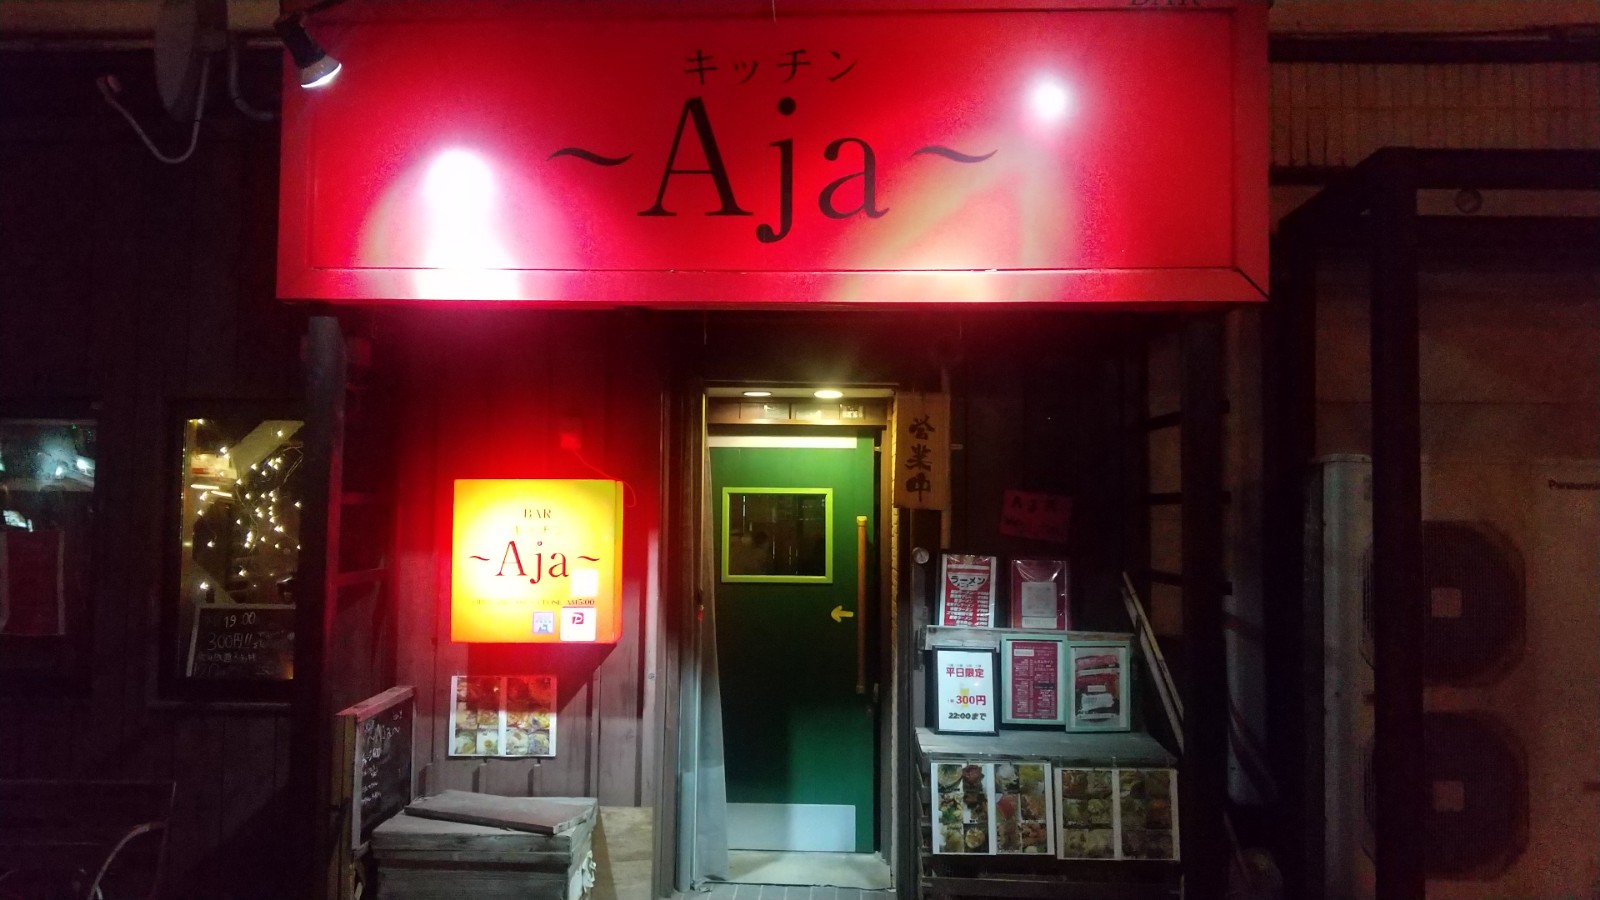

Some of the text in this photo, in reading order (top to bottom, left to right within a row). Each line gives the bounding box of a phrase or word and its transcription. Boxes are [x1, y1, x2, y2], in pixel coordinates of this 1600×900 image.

[683, 48, 859, 85] キッチン
[904, 414, 936, 502] 営業中
[524, 508, 552, 519] BAR
[950, 575, 986, 585] ラーメン
[945, 667, 985, 679] 平日限定
[956, 694, 987, 706] 300円
[948, 712, 987, 721] 22:00まで
